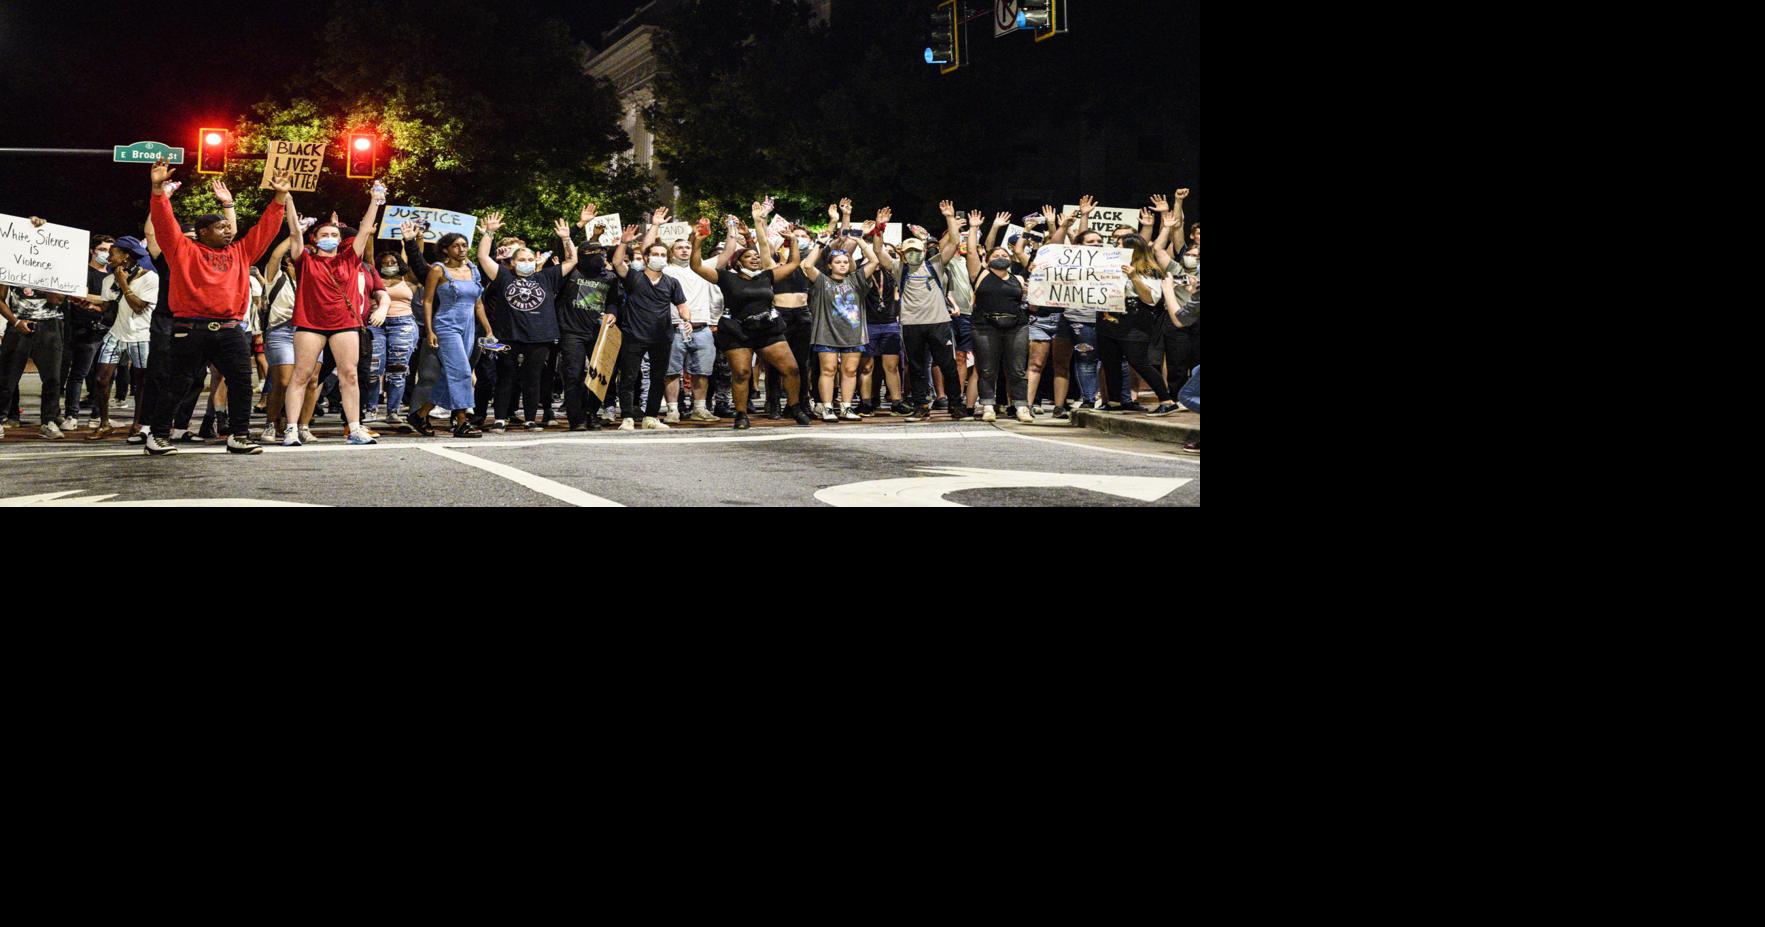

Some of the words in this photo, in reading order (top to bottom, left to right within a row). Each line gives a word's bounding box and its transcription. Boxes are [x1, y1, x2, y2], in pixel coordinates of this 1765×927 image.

[132, 150, 162, 159] Broad
[167, 152, 177, 160] St
[277, 142, 323, 156] BLACK
[274, 157, 318, 173] LIVES
[389, 208, 462, 226] JUSTICE
[0, 222, 31, 243] White
[36, 229, 70, 250] Silence
[659, 224, 685, 236] TAND
[30, 244, 39, 256] is
[1059, 249, 1098, 266] SAY
[14, 253, 53, 270] Violence
[1043, 267, 1100, 281] THEIR
[1049, 284, 1108, 305] NAMES
